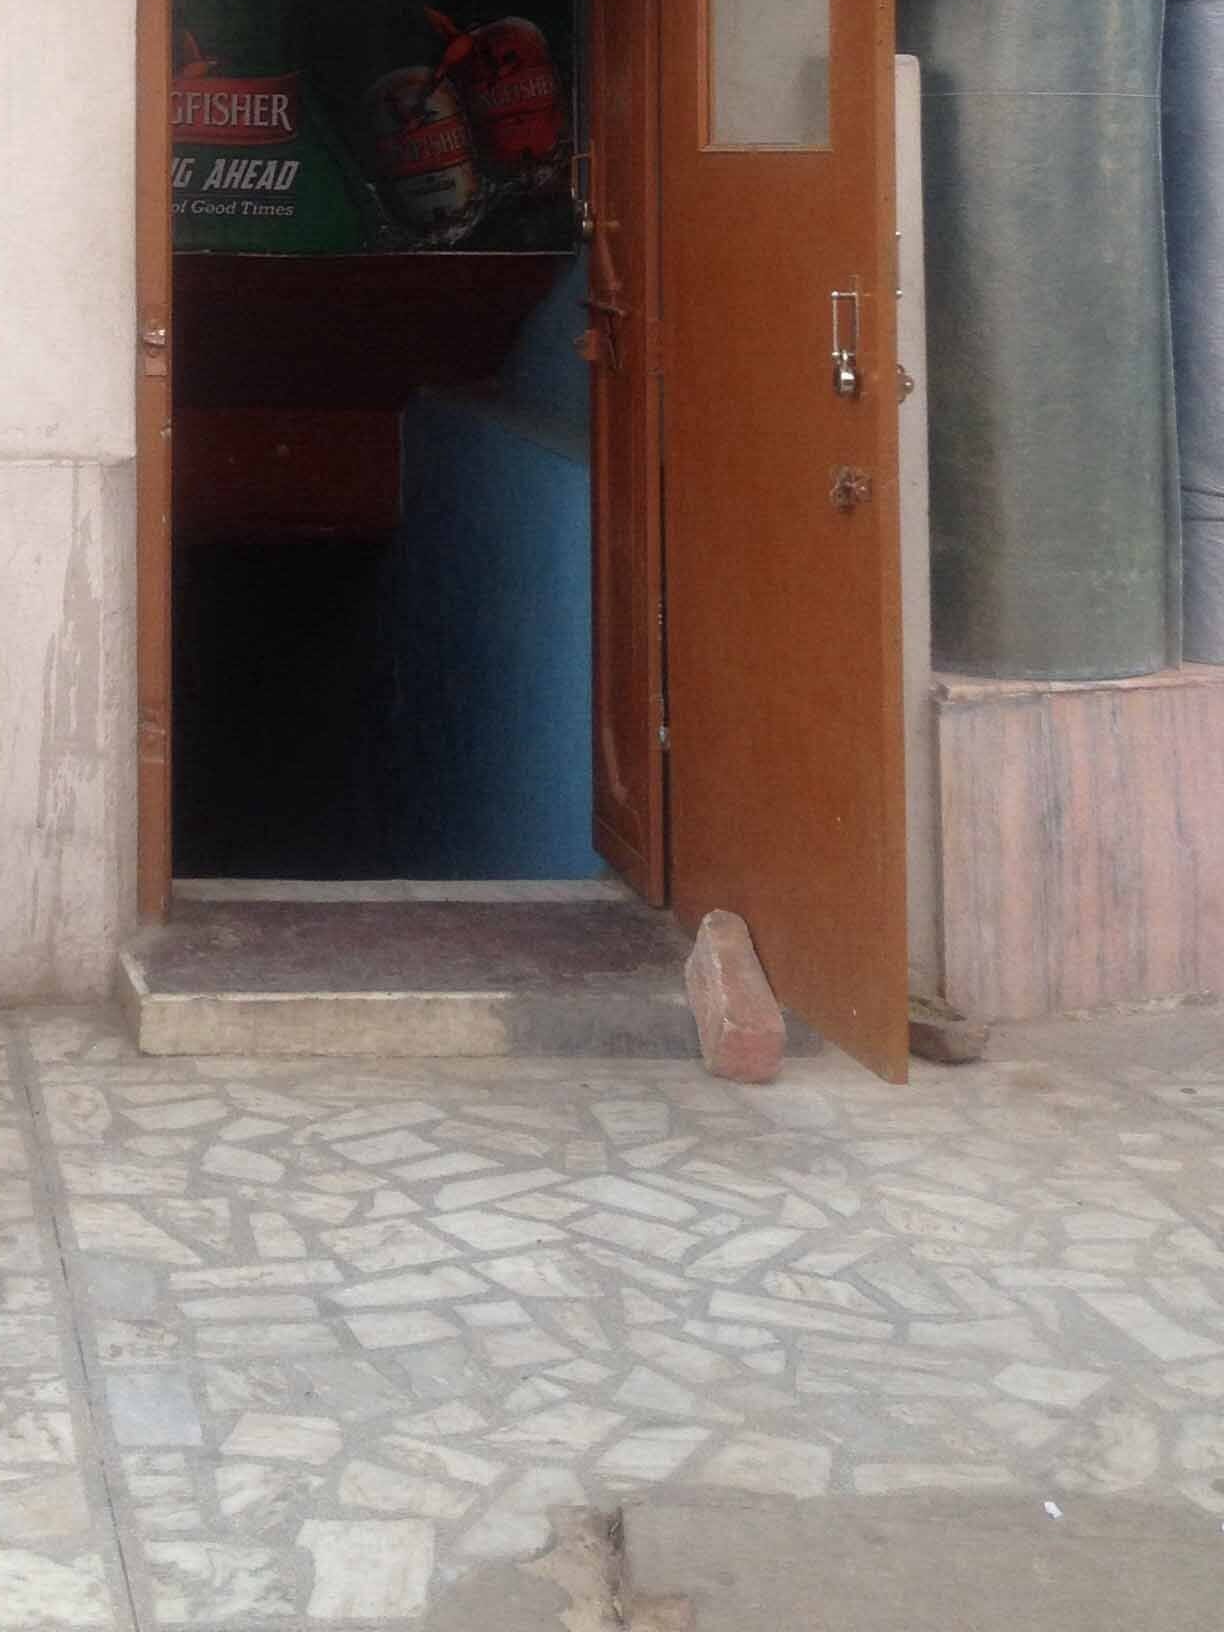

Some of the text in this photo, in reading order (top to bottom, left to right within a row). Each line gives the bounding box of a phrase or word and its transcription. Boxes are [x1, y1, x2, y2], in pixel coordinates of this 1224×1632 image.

[169, 91, 293, 132] GFISHER
[202, 158, 301, 191] AHEAD
[191, 200, 236, 215] Good
[241, 201, 294, 216] Times
